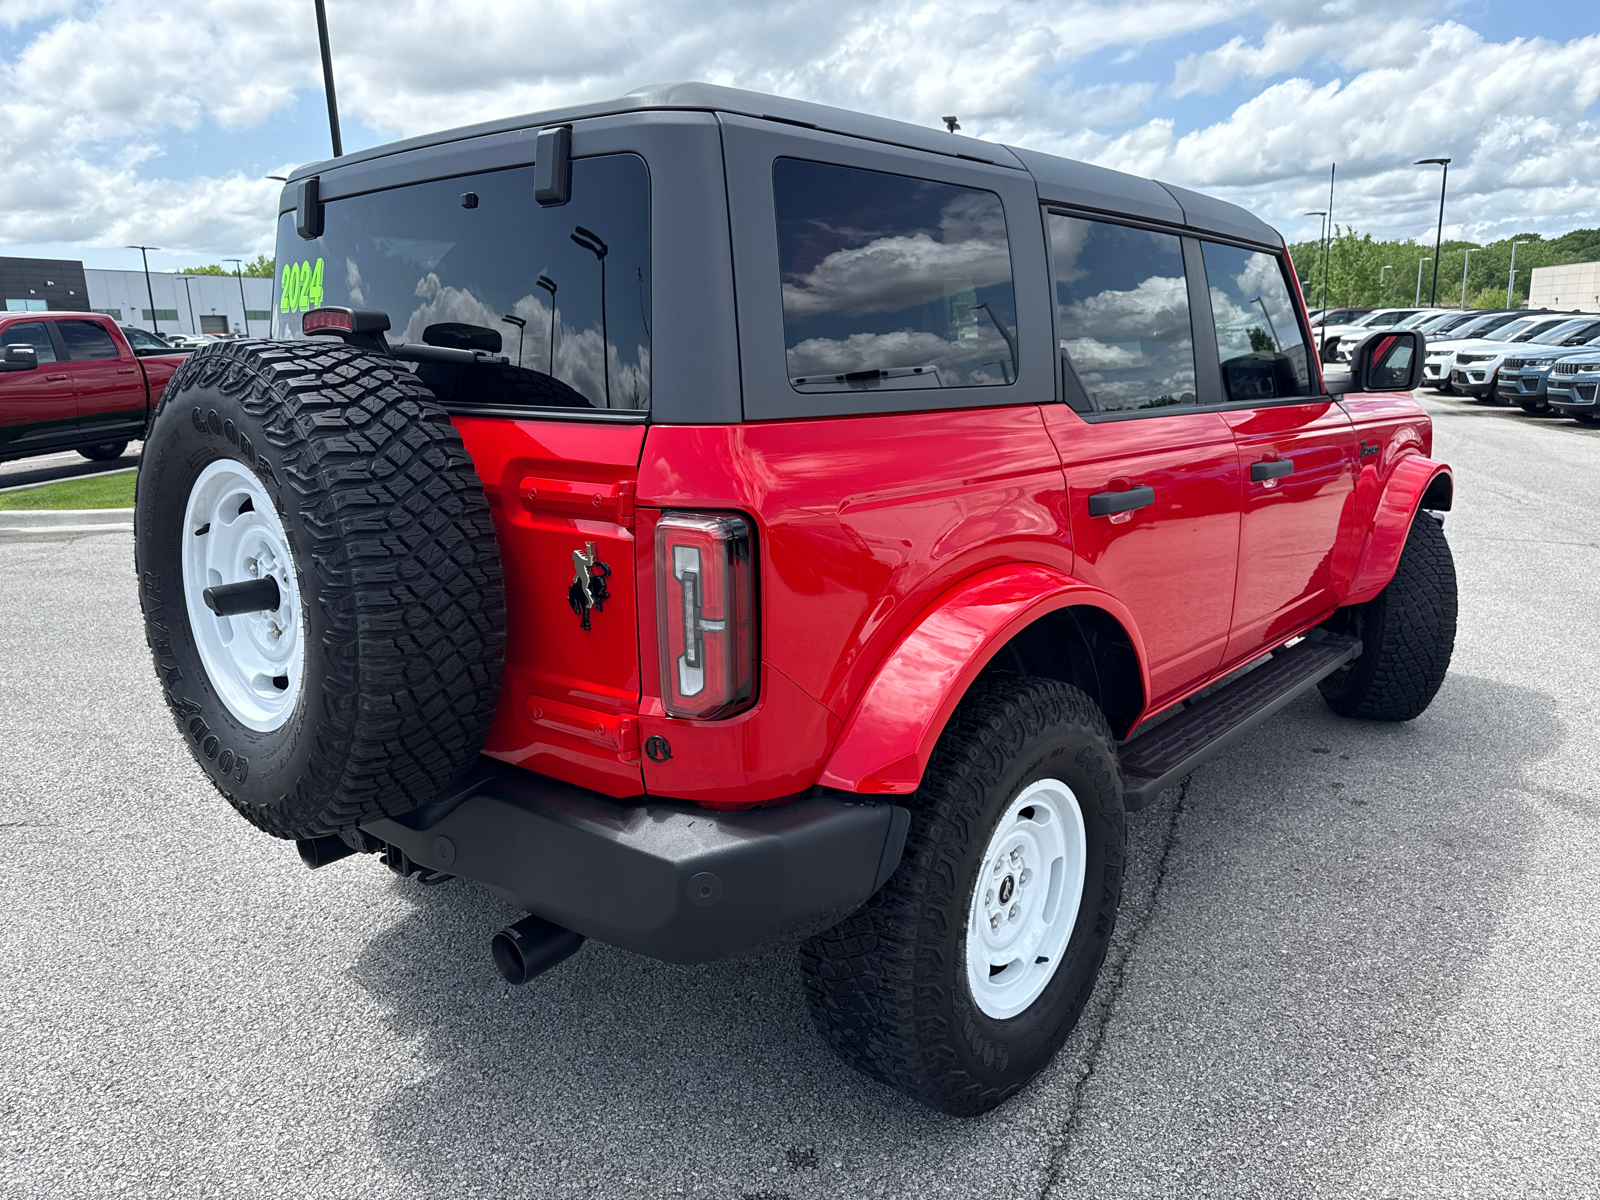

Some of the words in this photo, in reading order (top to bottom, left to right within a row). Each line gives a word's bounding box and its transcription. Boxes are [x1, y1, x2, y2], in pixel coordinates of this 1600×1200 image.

[280, 257, 324, 314] 2024
[143, 570, 250, 785] GOODYEAR
[1074, 743, 1125, 941] GOODYEAR
